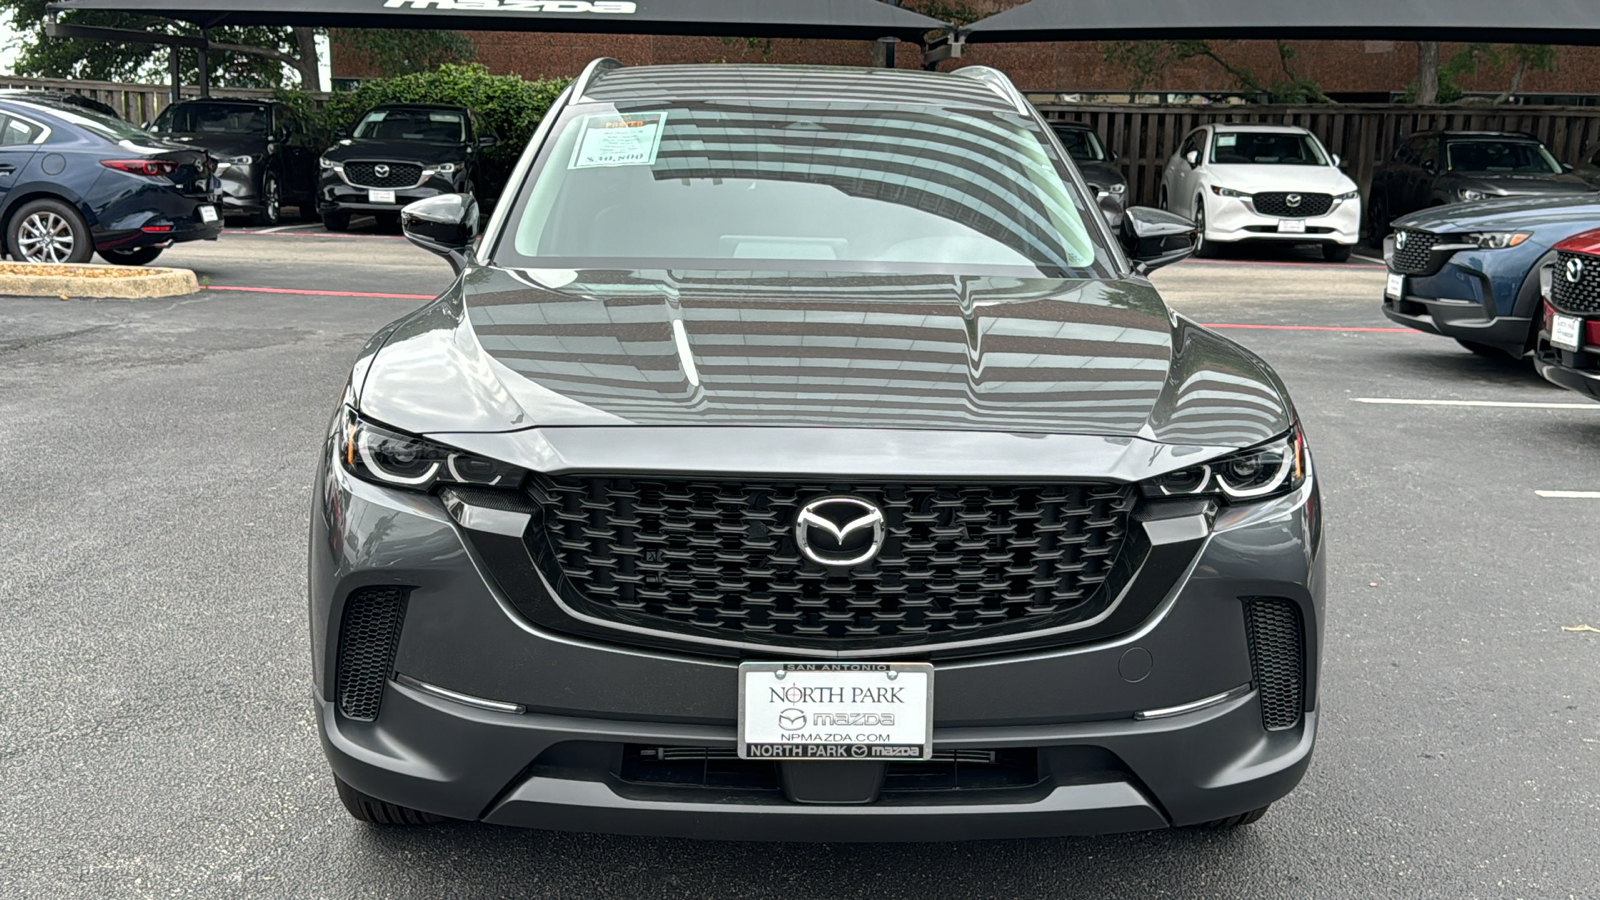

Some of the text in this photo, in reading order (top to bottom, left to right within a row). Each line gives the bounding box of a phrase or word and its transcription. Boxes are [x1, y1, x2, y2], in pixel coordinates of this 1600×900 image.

[383, 0, 637, 14] mazda
[769, 686, 905, 703] NORTH PARK
[813, 712, 895, 726] mazda
[781, 733, 890, 742] NPMAZDA.COM
[750, 745, 920, 757] NORTH PARK mazda
